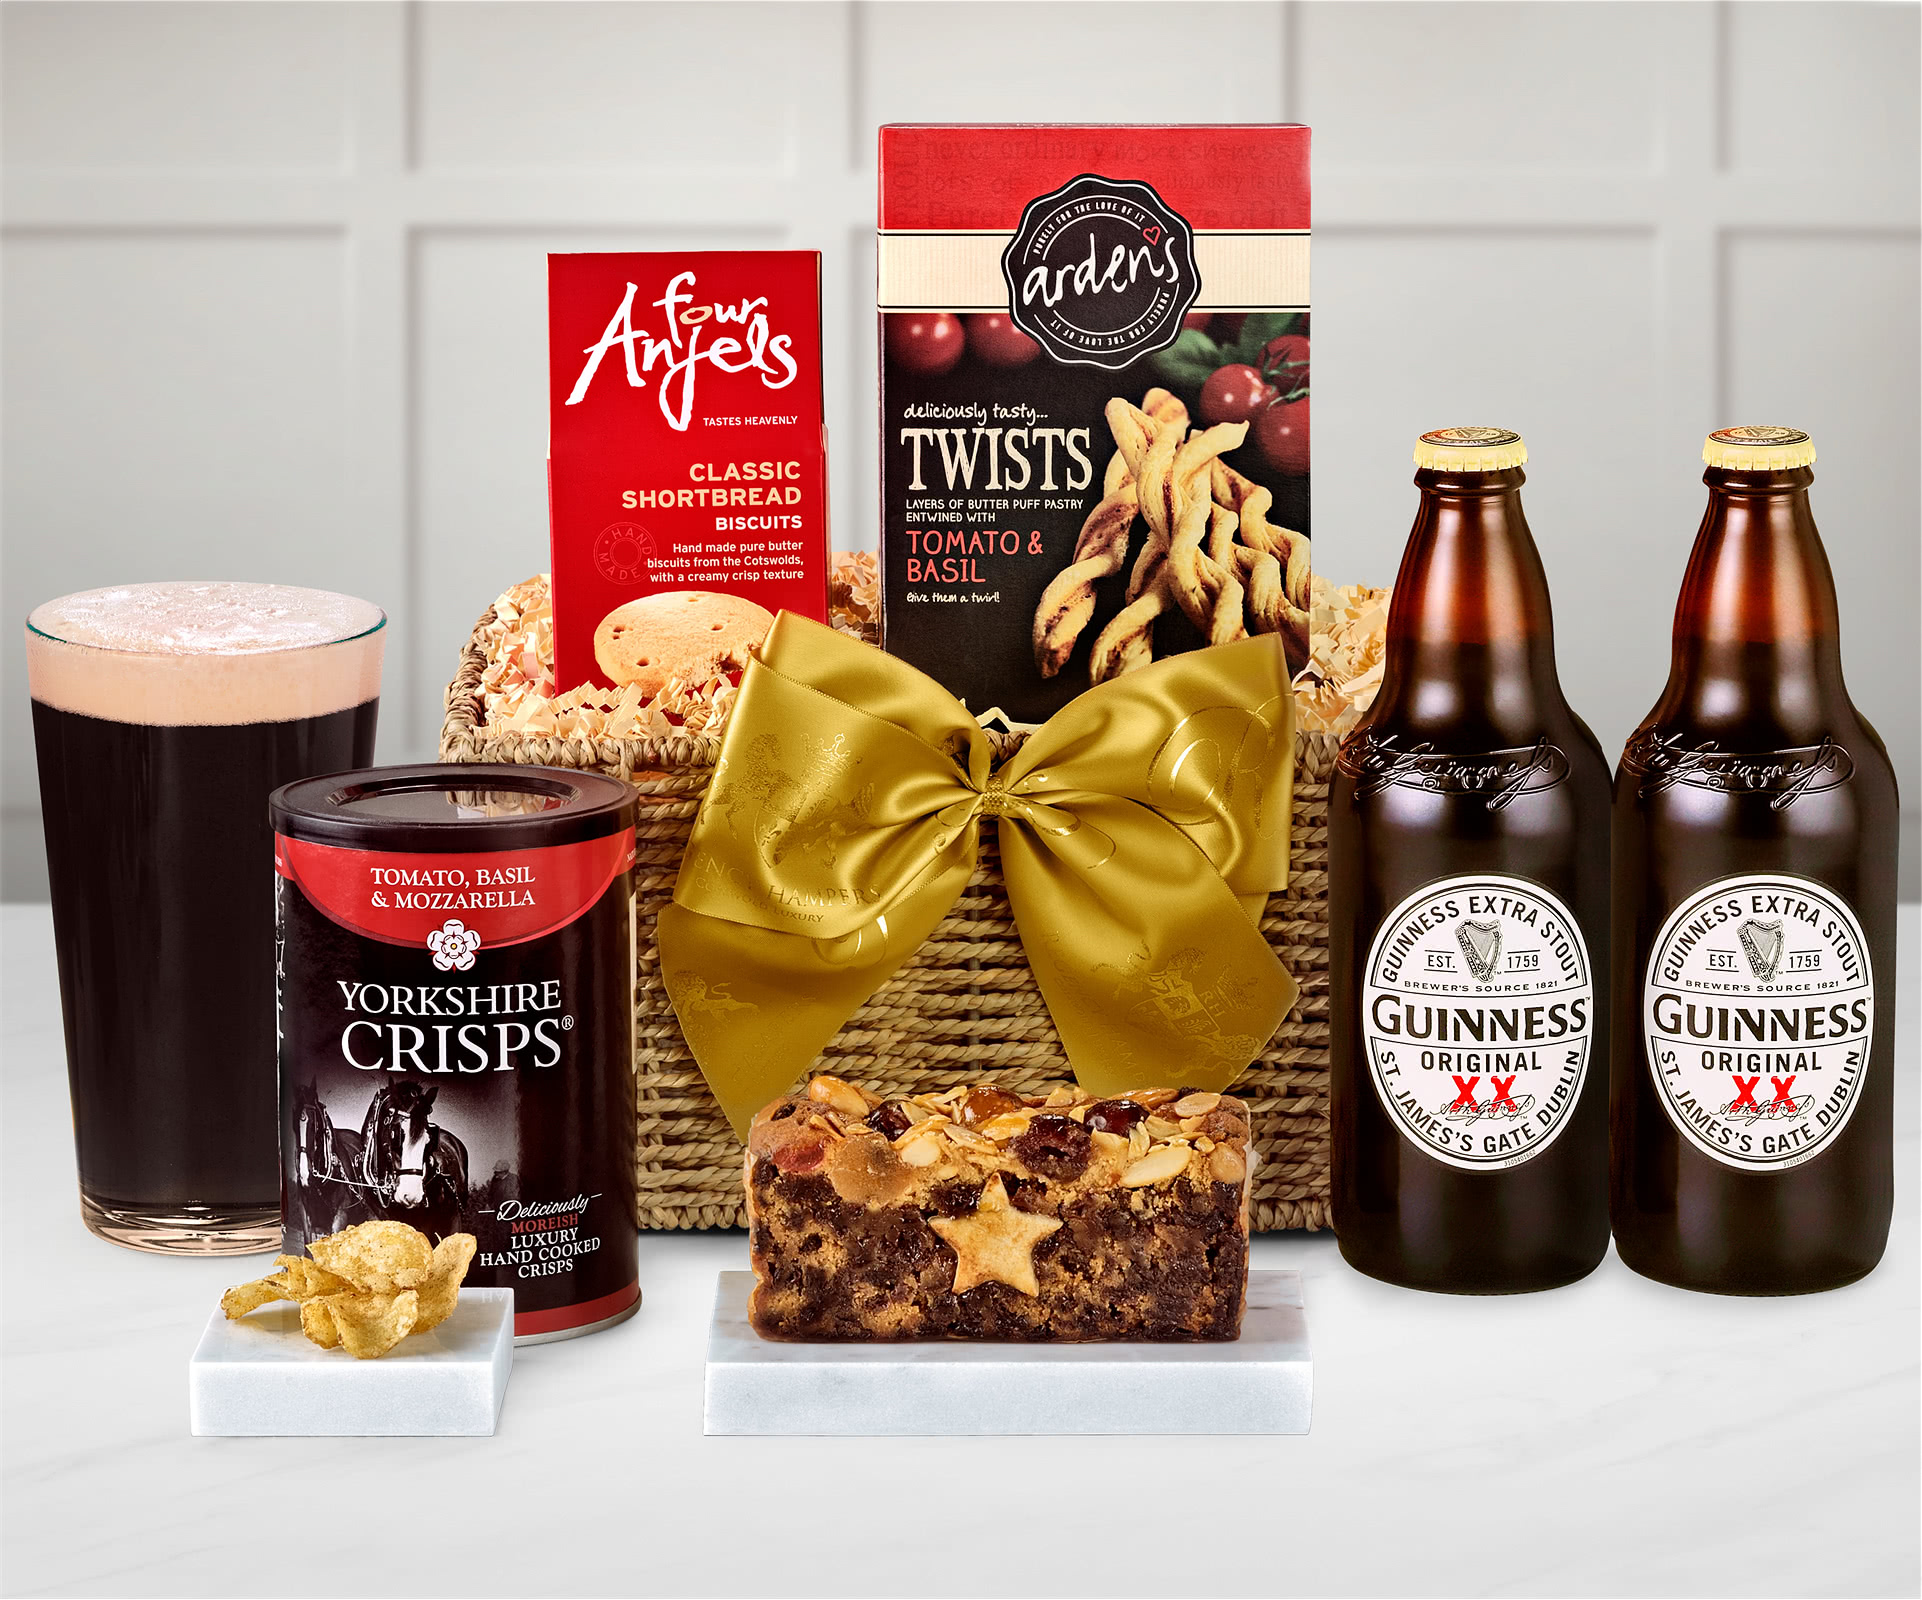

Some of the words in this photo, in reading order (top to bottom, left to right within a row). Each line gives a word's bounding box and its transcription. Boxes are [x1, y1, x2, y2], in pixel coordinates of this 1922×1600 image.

[1033, 223, 1057, 255] PURELY
[1055, 210, 1073, 225] FOR
[1074, 202, 1092, 215] THE
[1095, 201, 1119, 212] LOVE
[1121, 205, 1133, 217] OF
[1135, 212, 1147, 224] IT
[652, 271, 768, 349] four
[1062, 328, 1075, 340] OF
[1078, 336, 1102, 347] LOVE
[1107, 334, 1126, 346] THE
[1129, 322, 1147, 340] FOR
[703, 417, 742, 427] TASTES
[745, 415, 798, 426] HEAVENLY
[903, 402, 988, 427] deliciously
[992, 402, 1048, 427] tasty...
[900, 427, 1093, 491] TWISTS
[689, 461, 801, 482] CLASSIC
[621, 487, 802, 509] SHORTBREAD
[906, 499, 945, 510] LAYERS
[948, 499, 964, 510] OF
[968, 499, 1009, 510] BUTTER
[1013, 499, 1041, 510] PUFF
[1044, 499, 1084, 510] PASTRY
[715, 515, 803, 531] BISCUITS
[906, 512, 963, 523] ENTWINED
[966, 512, 996, 523] WITH
[673, 543, 703, 554] Hand
[705, 542, 737, 553] made
[740, 543, 766, 555] pure
[768, 541, 804, 552] butter
[905, 530, 1020, 555] TOMATO
[1027, 530, 1044, 555] &
[647, 557, 691, 569] biscuits
[693, 556, 720, 568] from
[723, 556, 741, 567] the
[743, 555, 805, 568] Cotswolds,
[907, 558, 986, 583] BASIL
[650, 571, 675, 583] with
[677, 573, 685, 582] a
[687, 572, 729, 585] creamy
[732, 570, 760, 583] crisp
[763, 569, 804, 581] texture
[906, 591, 929, 604] Give
[932, 591, 958, 603] them
[960, 595, 969, 603] a
[370, 867, 470, 890] TOMATO,
[476, 866, 536, 886] BASIL
[371, 891, 390, 908] &
[394, 889, 536, 910] MOZZARELLA
[768, 884, 882, 909] HAMPERS
[774, 907, 824, 922] LUXURY
[1382, 900, 1460, 983] GUINNESS
[1468, 895, 1539, 928] EXTRA
[1540, 921, 1579, 983] STOUT
[1663, 899, 1742, 982] GUINNESS
[1751, 895, 1821, 927] EXTRA
[1822, 920, 1860, 982] STOUT
[1428, 954, 1456, 969] EST.
[1507, 954, 1539, 969] 1759
[1709, 954, 1737, 969] EST.
[1789, 954, 1820, 969] 1759
[1404, 980, 1470, 992] BREWER'S
[1475, 983, 1530, 992] SOURCE
[1535, 980, 1558, 990] 1821
[1686, 980, 1751, 992] BREWER'S
[1757, 983, 1811, 992] SOURCE
[1817, 980, 1839, 990] 1821
[336, 979, 562, 1017] YORKSHIRE
[1372, 993, 1587, 1042] GUINNESS
[1653, 993, 1867, 1042] GUINNESS
[1421, 1051, 1542, 1073] ORIGINAL
[1701, 1050, 1822, 1073] ORIGINAL
[1380, 1051, 1402, 1087] ST.
[1395, 1090, 1473, 1152] JAMES'S
[1483, 1122, 1537, 1153] GATE
[1536, 1051, 1580, 1127] DUBLIN
[1660, 1050, 1682, 1086] ST.
[1675, 1089, 1753, 1152] JAMES'S
[1762, 1122, 1816, 1154] GATE
[1815, 1050, 1860, 1127] DUBLIN
[496, 1194, 590, 1221] Deliciously
[511, 1213, 579, 1234] MOREISH
[511, 1227, 579, 1249] LUXURY
[480, 1251, 533, 1266] HAND
[538, 1237, 601, 1262] COOKED
[518, 1258, 574, 1279] CRISPS
